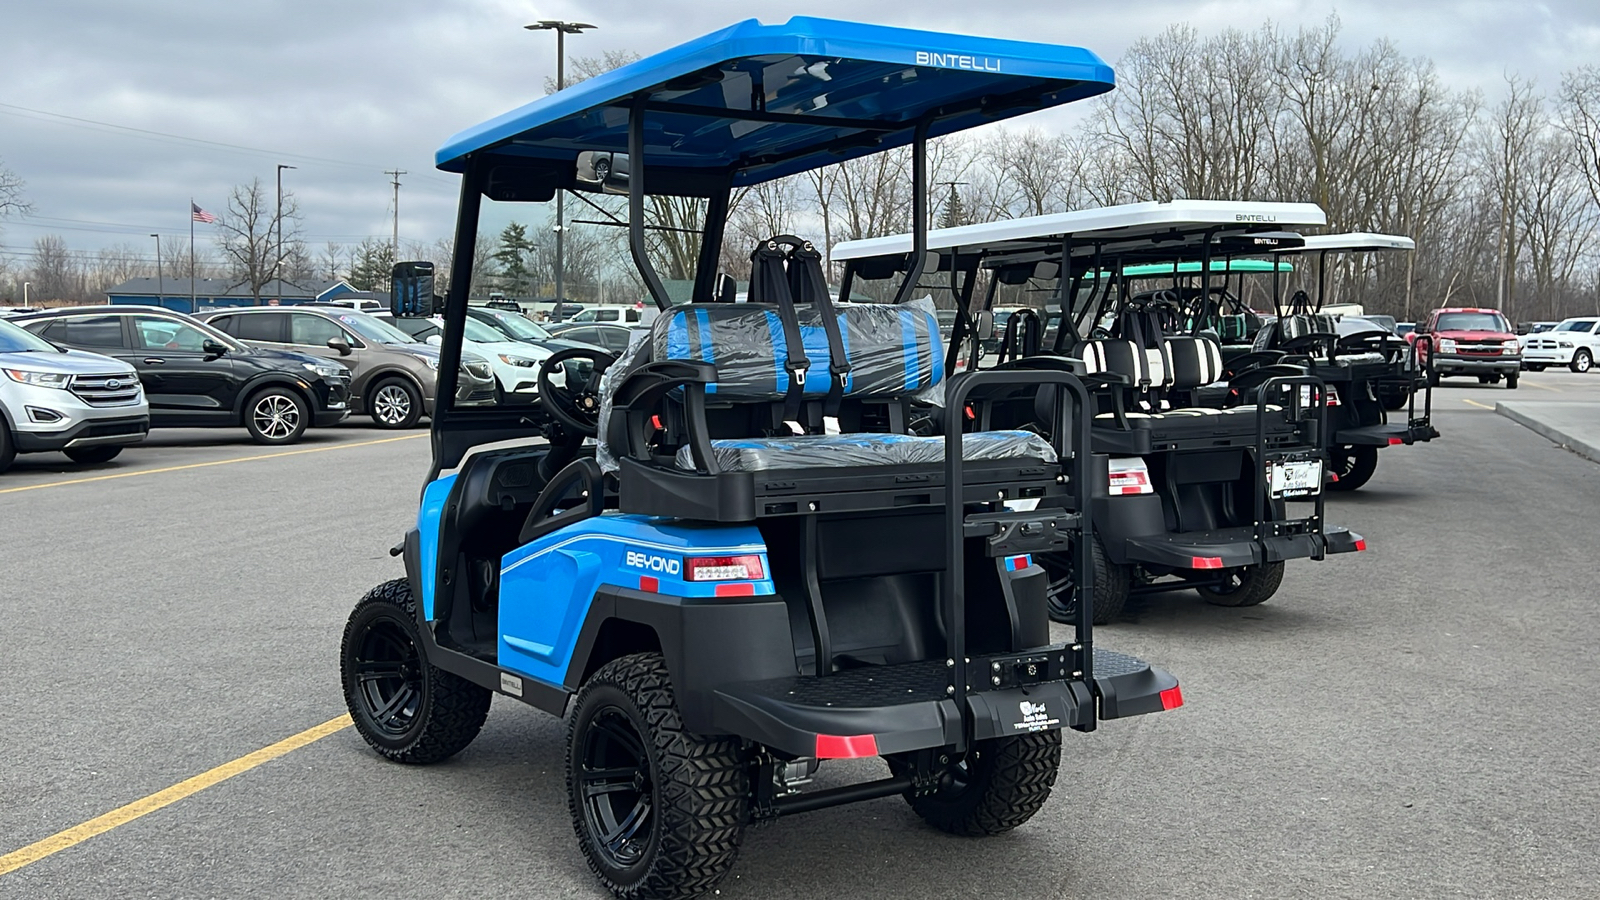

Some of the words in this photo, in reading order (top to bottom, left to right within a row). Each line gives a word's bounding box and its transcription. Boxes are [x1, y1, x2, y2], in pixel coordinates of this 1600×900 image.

[916, 51, 1001, 72] BINTELLI
[1235, 214, 1276, 222] BINTELLI
[626, 551, 680, 575] BEYOND
